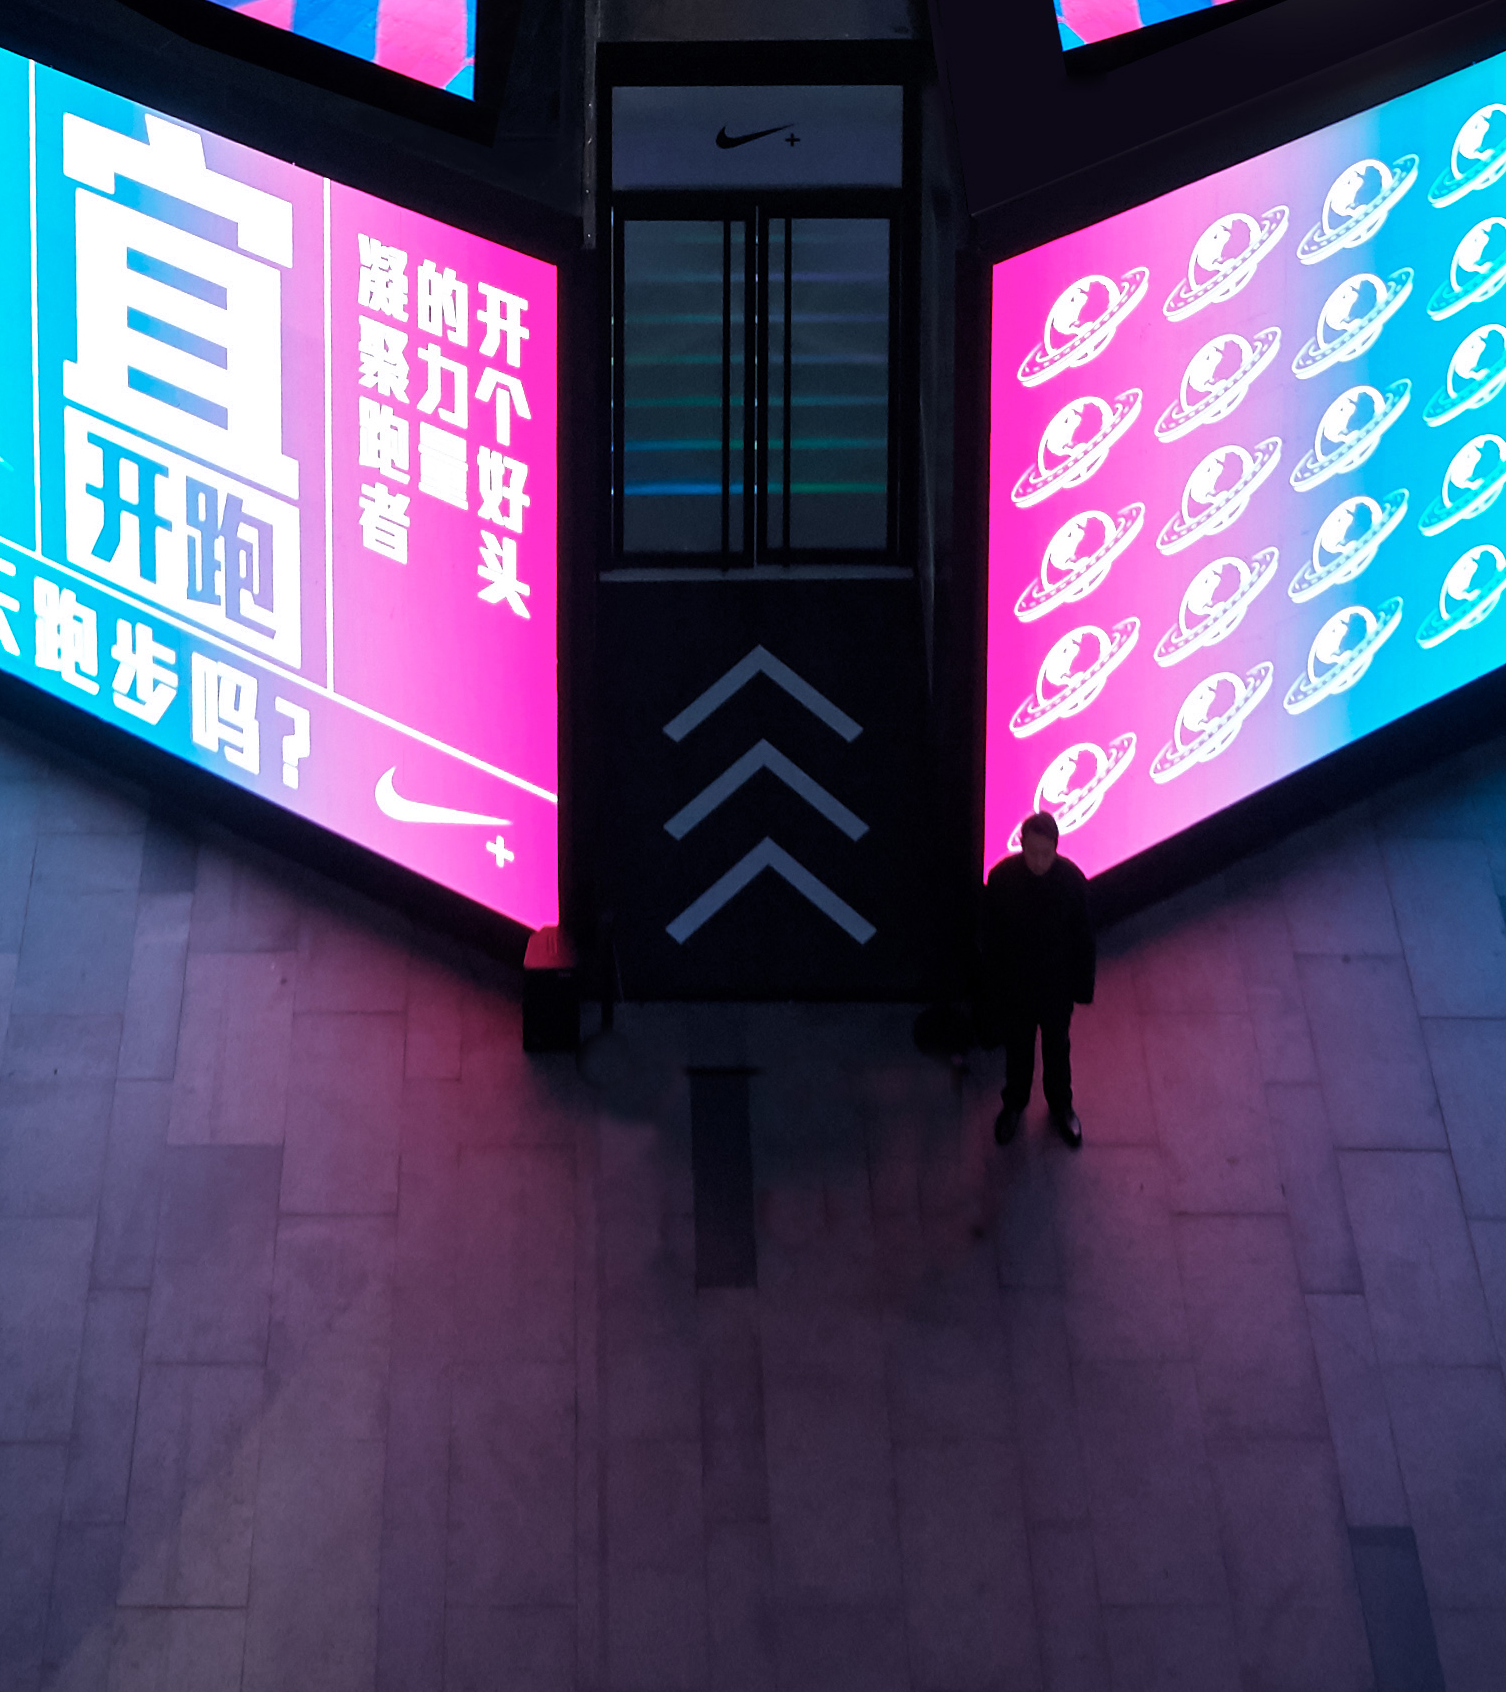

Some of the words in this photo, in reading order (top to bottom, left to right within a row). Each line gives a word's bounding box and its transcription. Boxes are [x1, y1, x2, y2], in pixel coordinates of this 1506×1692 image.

[62, 111, 299, 500] 宜
[357, 232, 410, 565] 凝聚跑者
[416, 258, 469, 512] 的力量
[475, 281, 532, 620] 开个好头
[84, 430, 278, 642] 开跑
